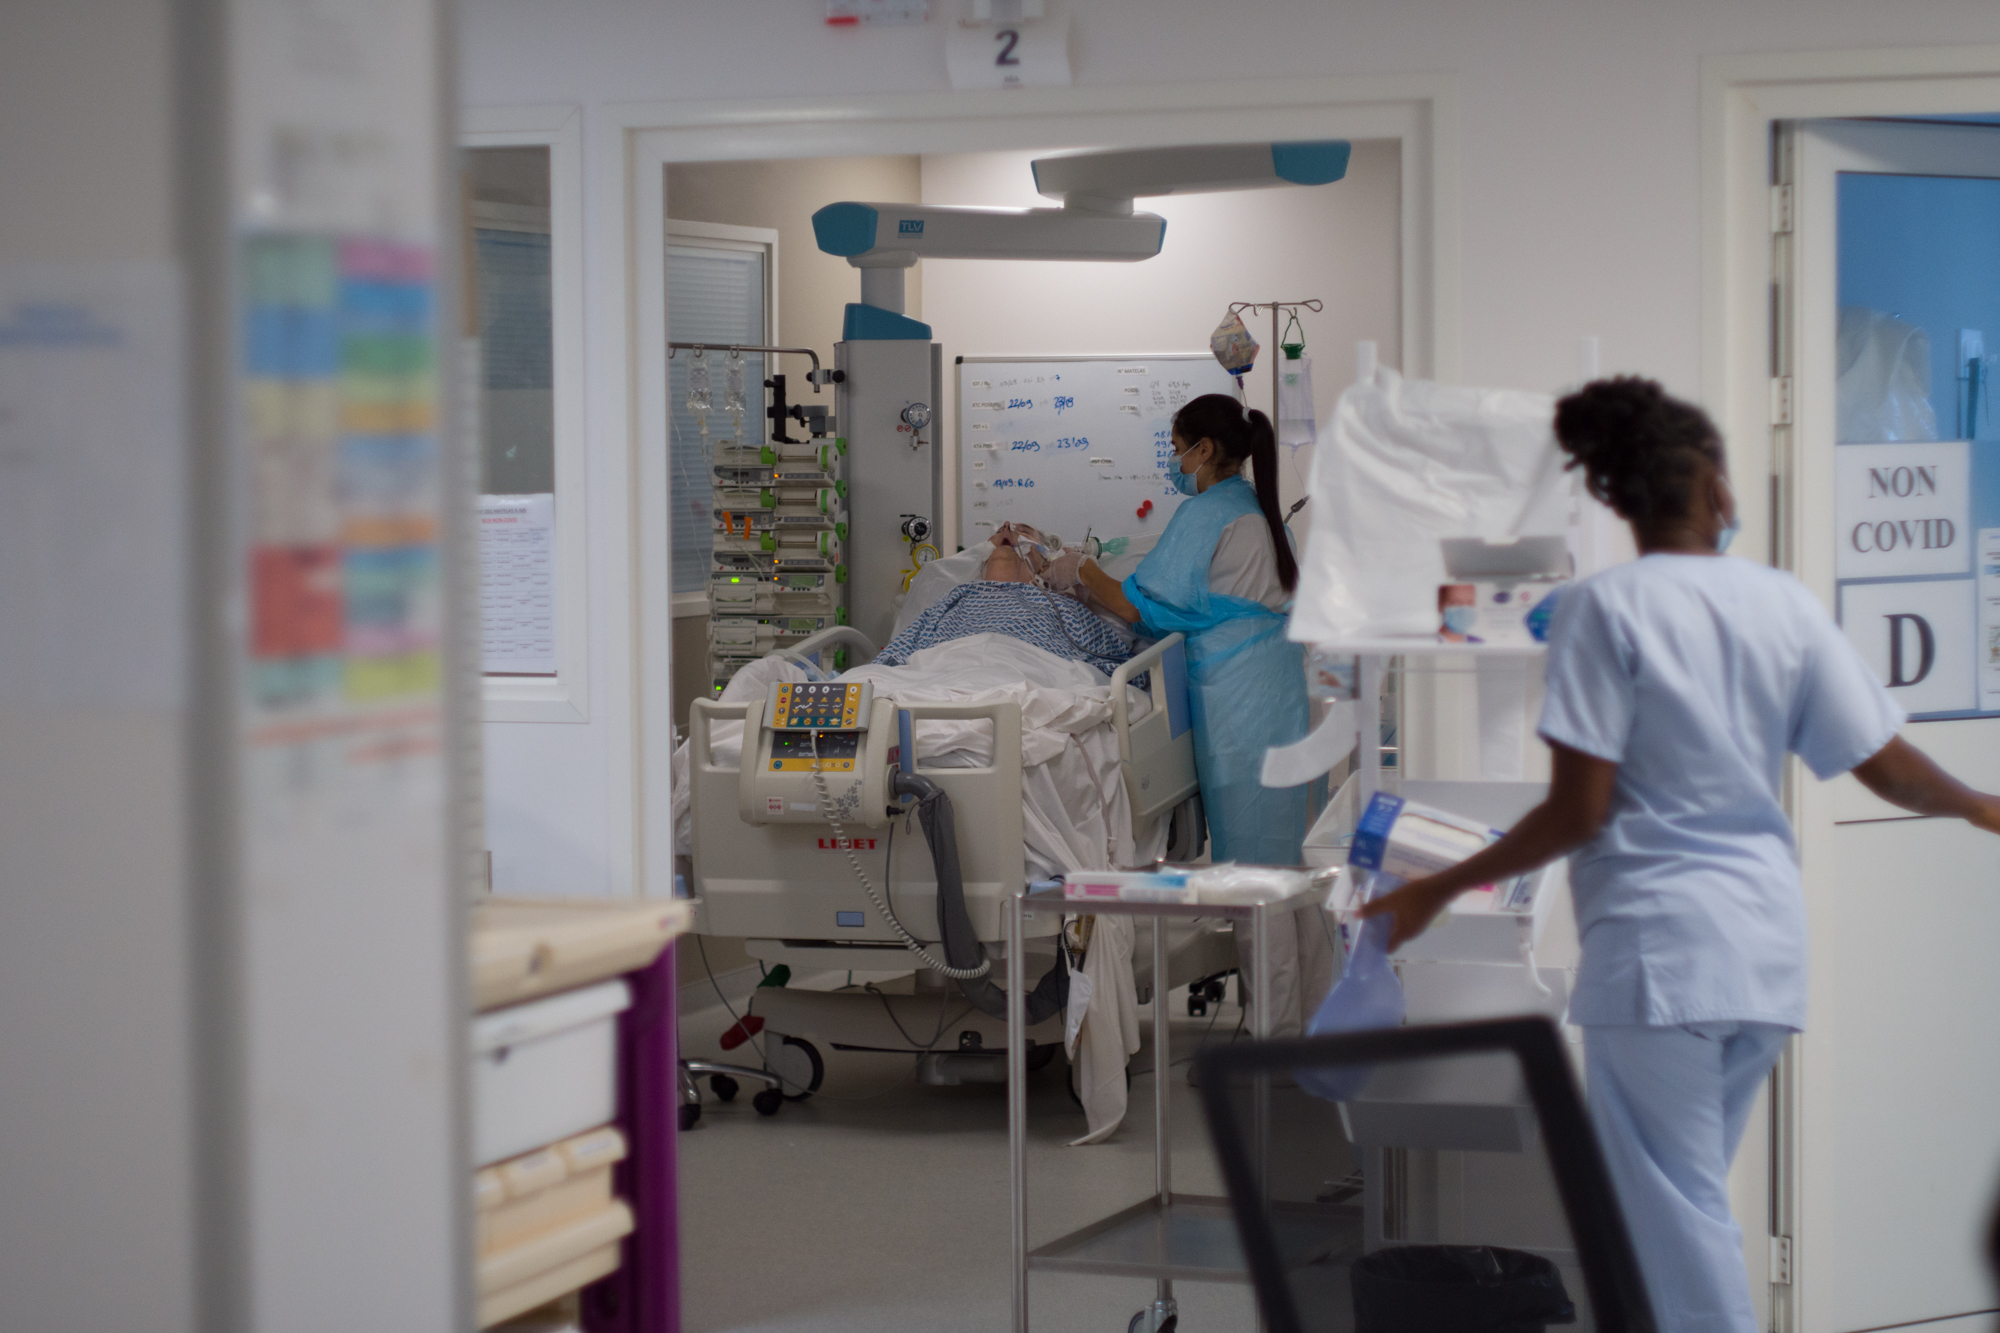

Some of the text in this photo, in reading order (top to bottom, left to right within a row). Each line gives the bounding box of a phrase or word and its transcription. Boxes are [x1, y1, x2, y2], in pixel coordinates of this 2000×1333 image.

[994, 29, 1020, 66] 2
[901, 221, 923, 232] TLV
[1007, 398, 1034, 409] 22/09
[1011, 439, 1041, 452] 22/09
[1868, 465, 1938, 498] NON
[1852, 518, 1955, 553] COVID
[1882, 612, 1936, 688] D
